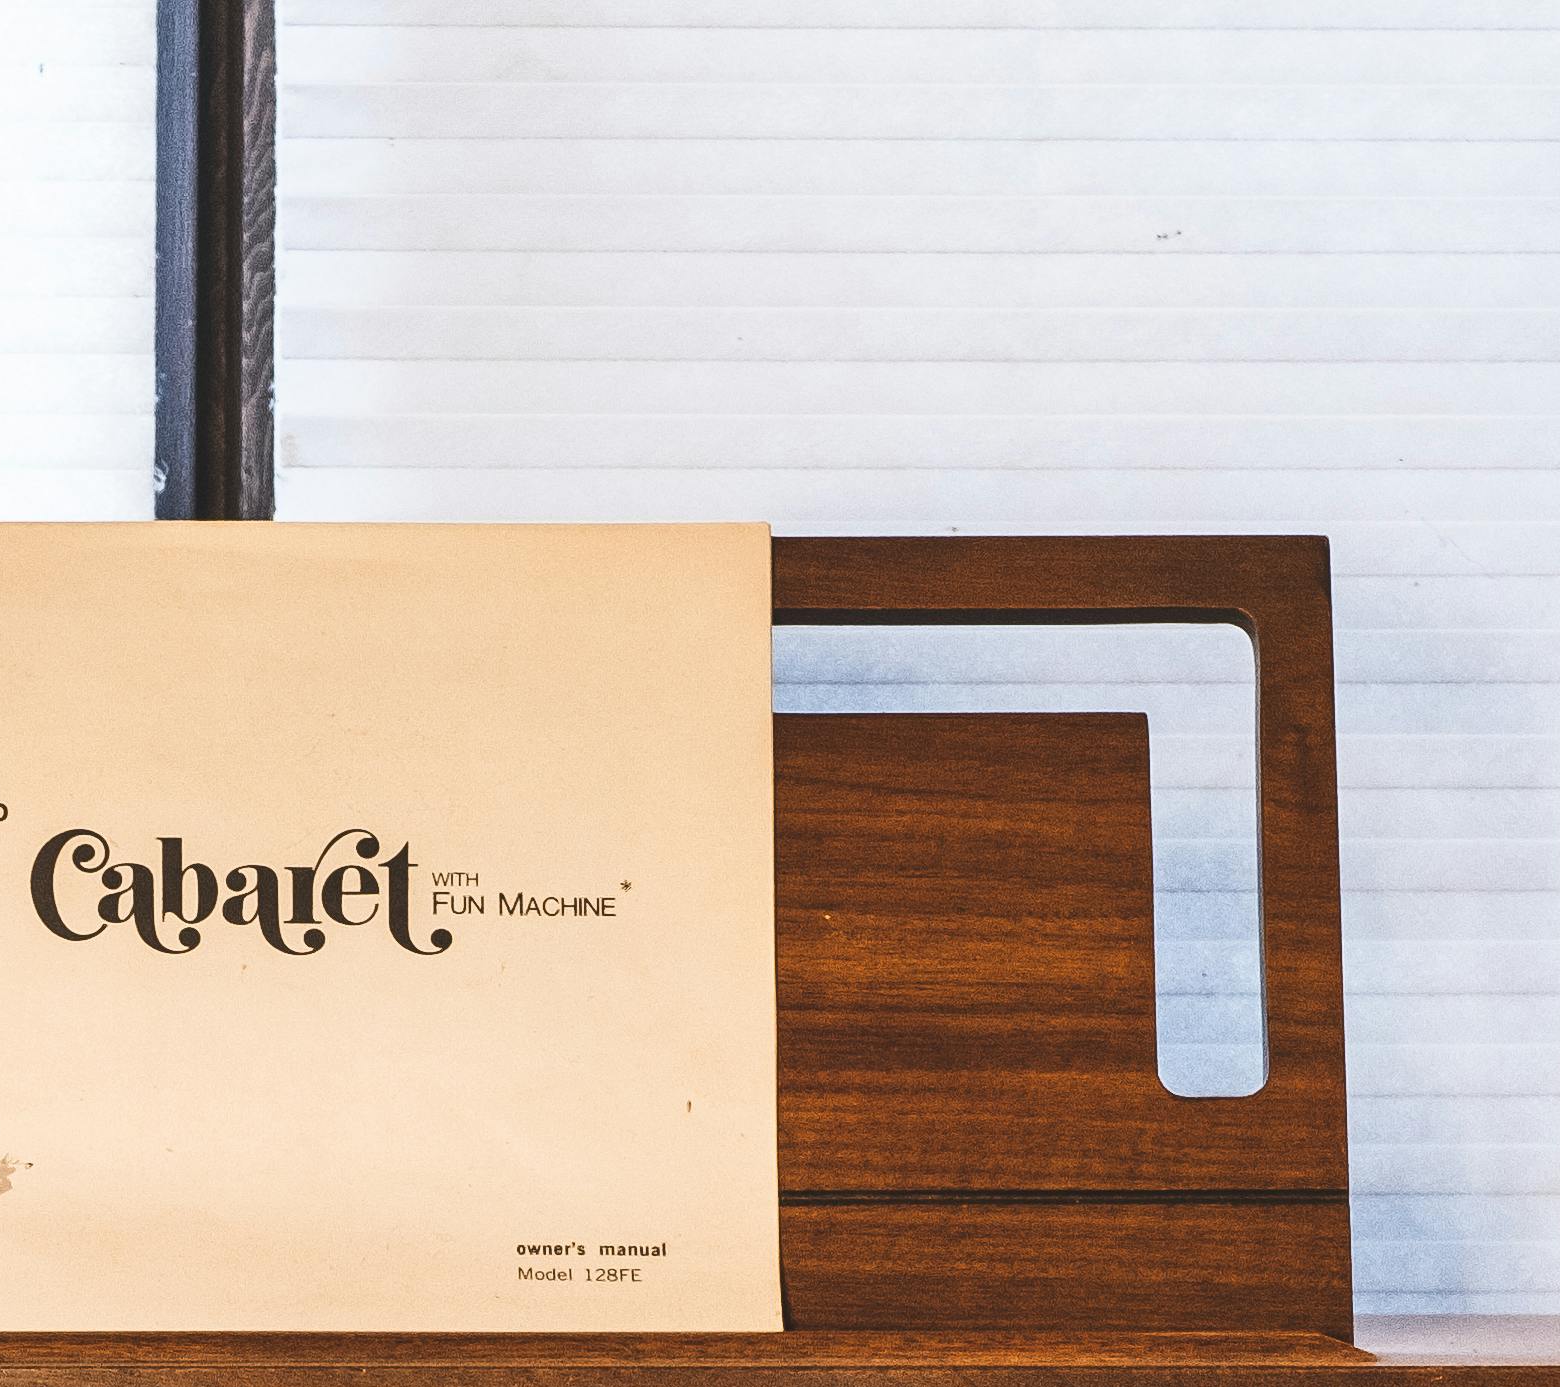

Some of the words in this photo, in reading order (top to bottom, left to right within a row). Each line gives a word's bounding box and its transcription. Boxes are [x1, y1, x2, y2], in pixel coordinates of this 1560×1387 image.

[432, 871, 479, 888] WITH
[30, 828, 453, 956] Cabaret
[432, 892, 485, 915] FUN
[516, 1241, 586, 1256] owner's
[599, 1242, 667, 1257] manual
[518, 1266, 573, 1281] Model
[585, 1268, 643, 1282] 128FE
